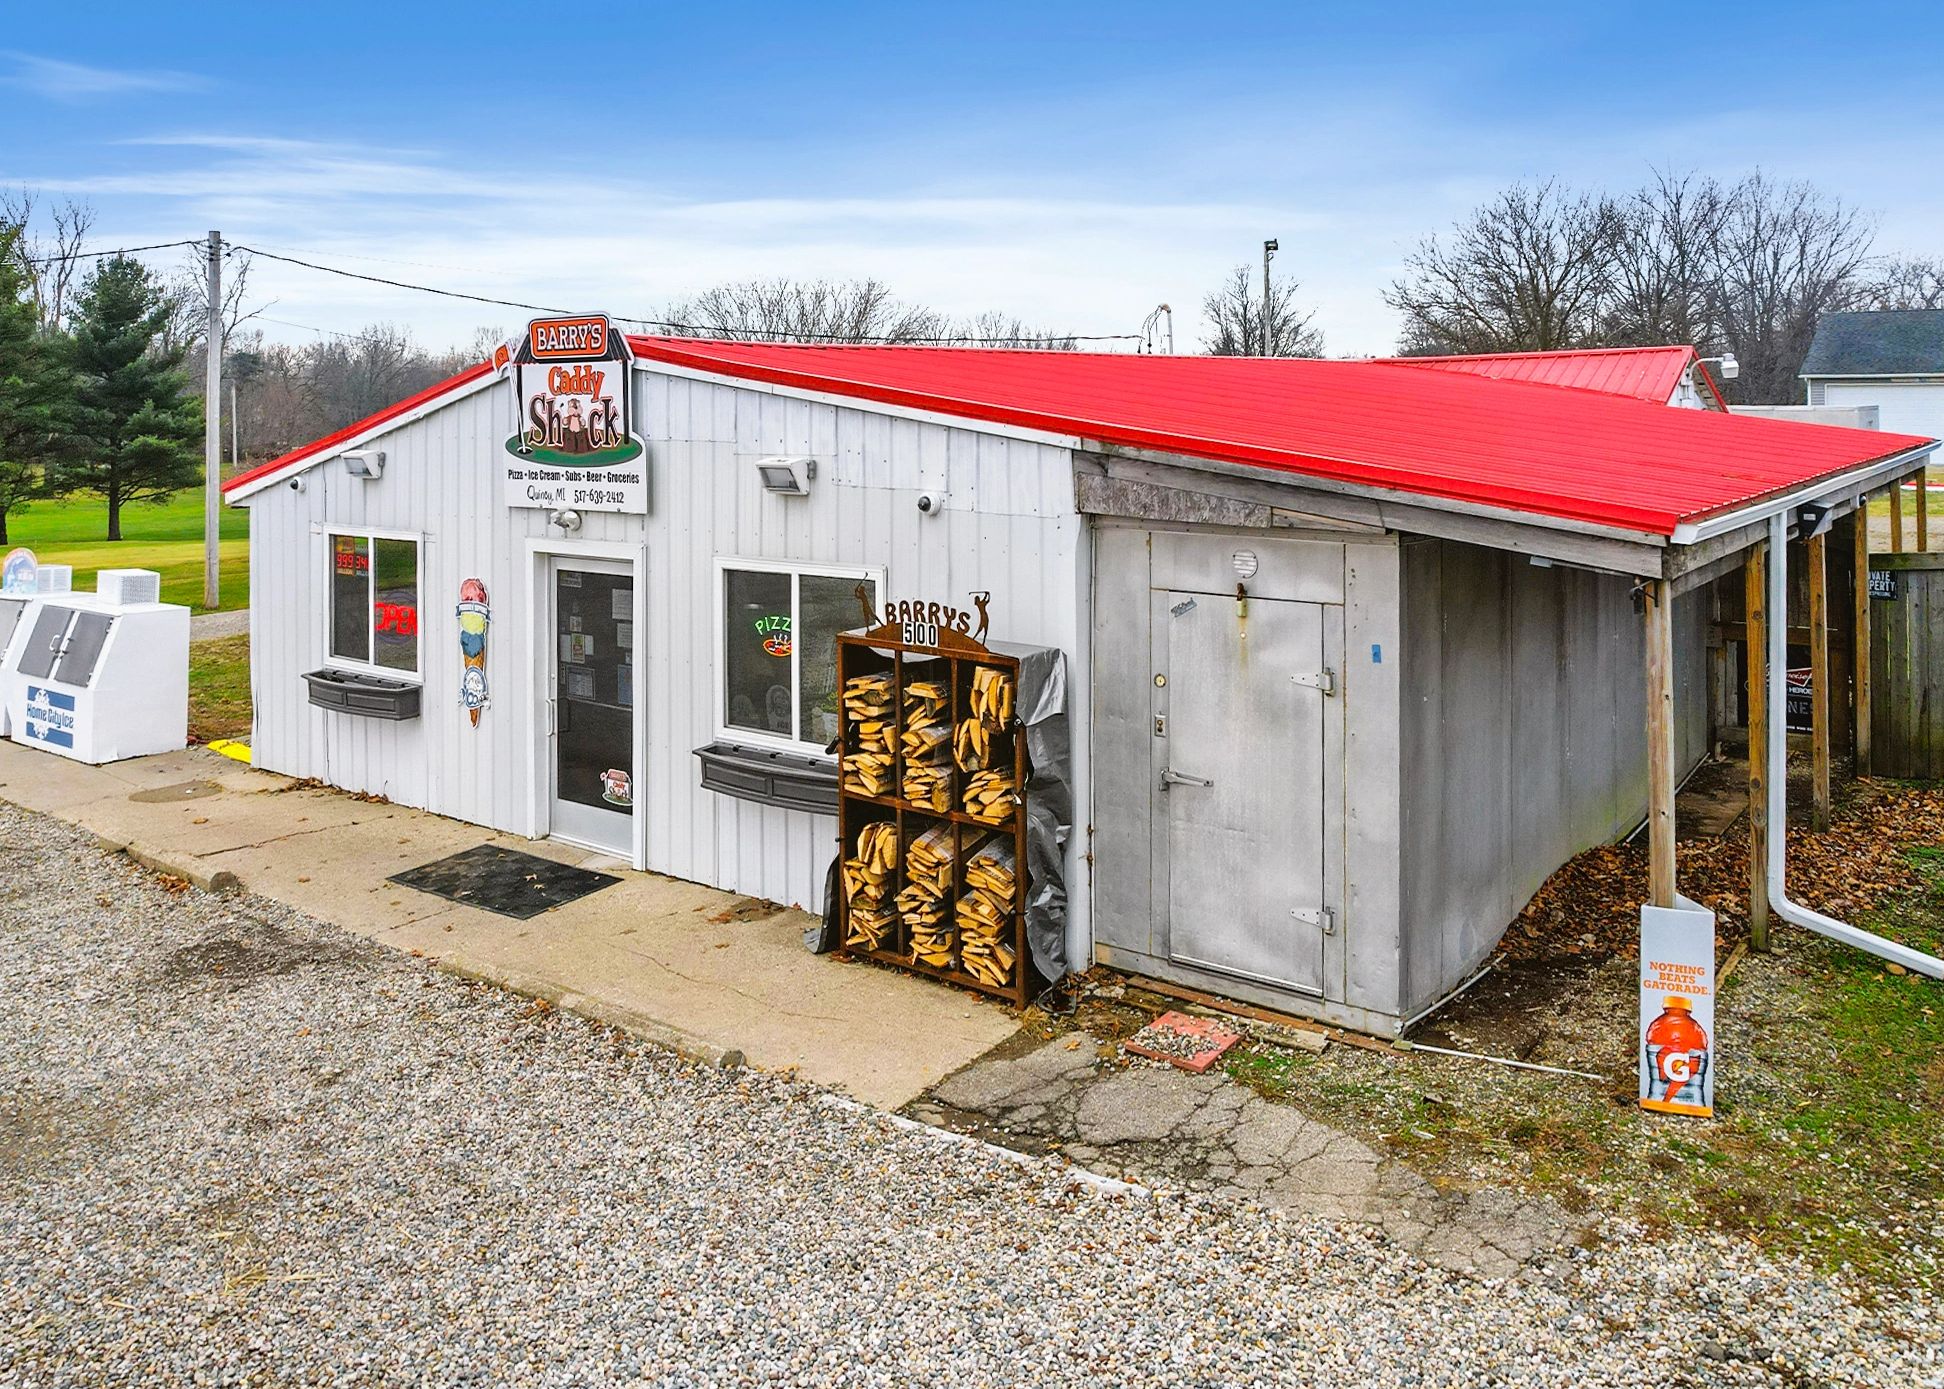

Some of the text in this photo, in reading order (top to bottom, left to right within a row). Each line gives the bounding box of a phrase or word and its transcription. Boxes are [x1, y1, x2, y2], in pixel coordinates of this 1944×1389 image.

[537, 324, 602, 351] BARRY'S
[548, 365, 605, 402] Caddy
[528, 394, 621, 447] Shck
[508, 469, 639, 484] Pizza Ice Cream Subs Beer Groceries
[555, 488, 566, 502] MI
[574, 490, 624, 504] 517-639-2412
[1869, 580, 1896, 592] PERTY
[755, 616, 791, 635] PIZZ
[885, 600, 971, 635] BARRYS
[904, 622, 936, 646] 500
[27, 703, 74, 728] Home City Ice
[1649, 961, 1705, 976] NOTHING
[1659, 972, 1695, 984] BEATS
[1643, 980, 1711, 996] GATORADE.
[1663, 1052, 1690, 1082] G
